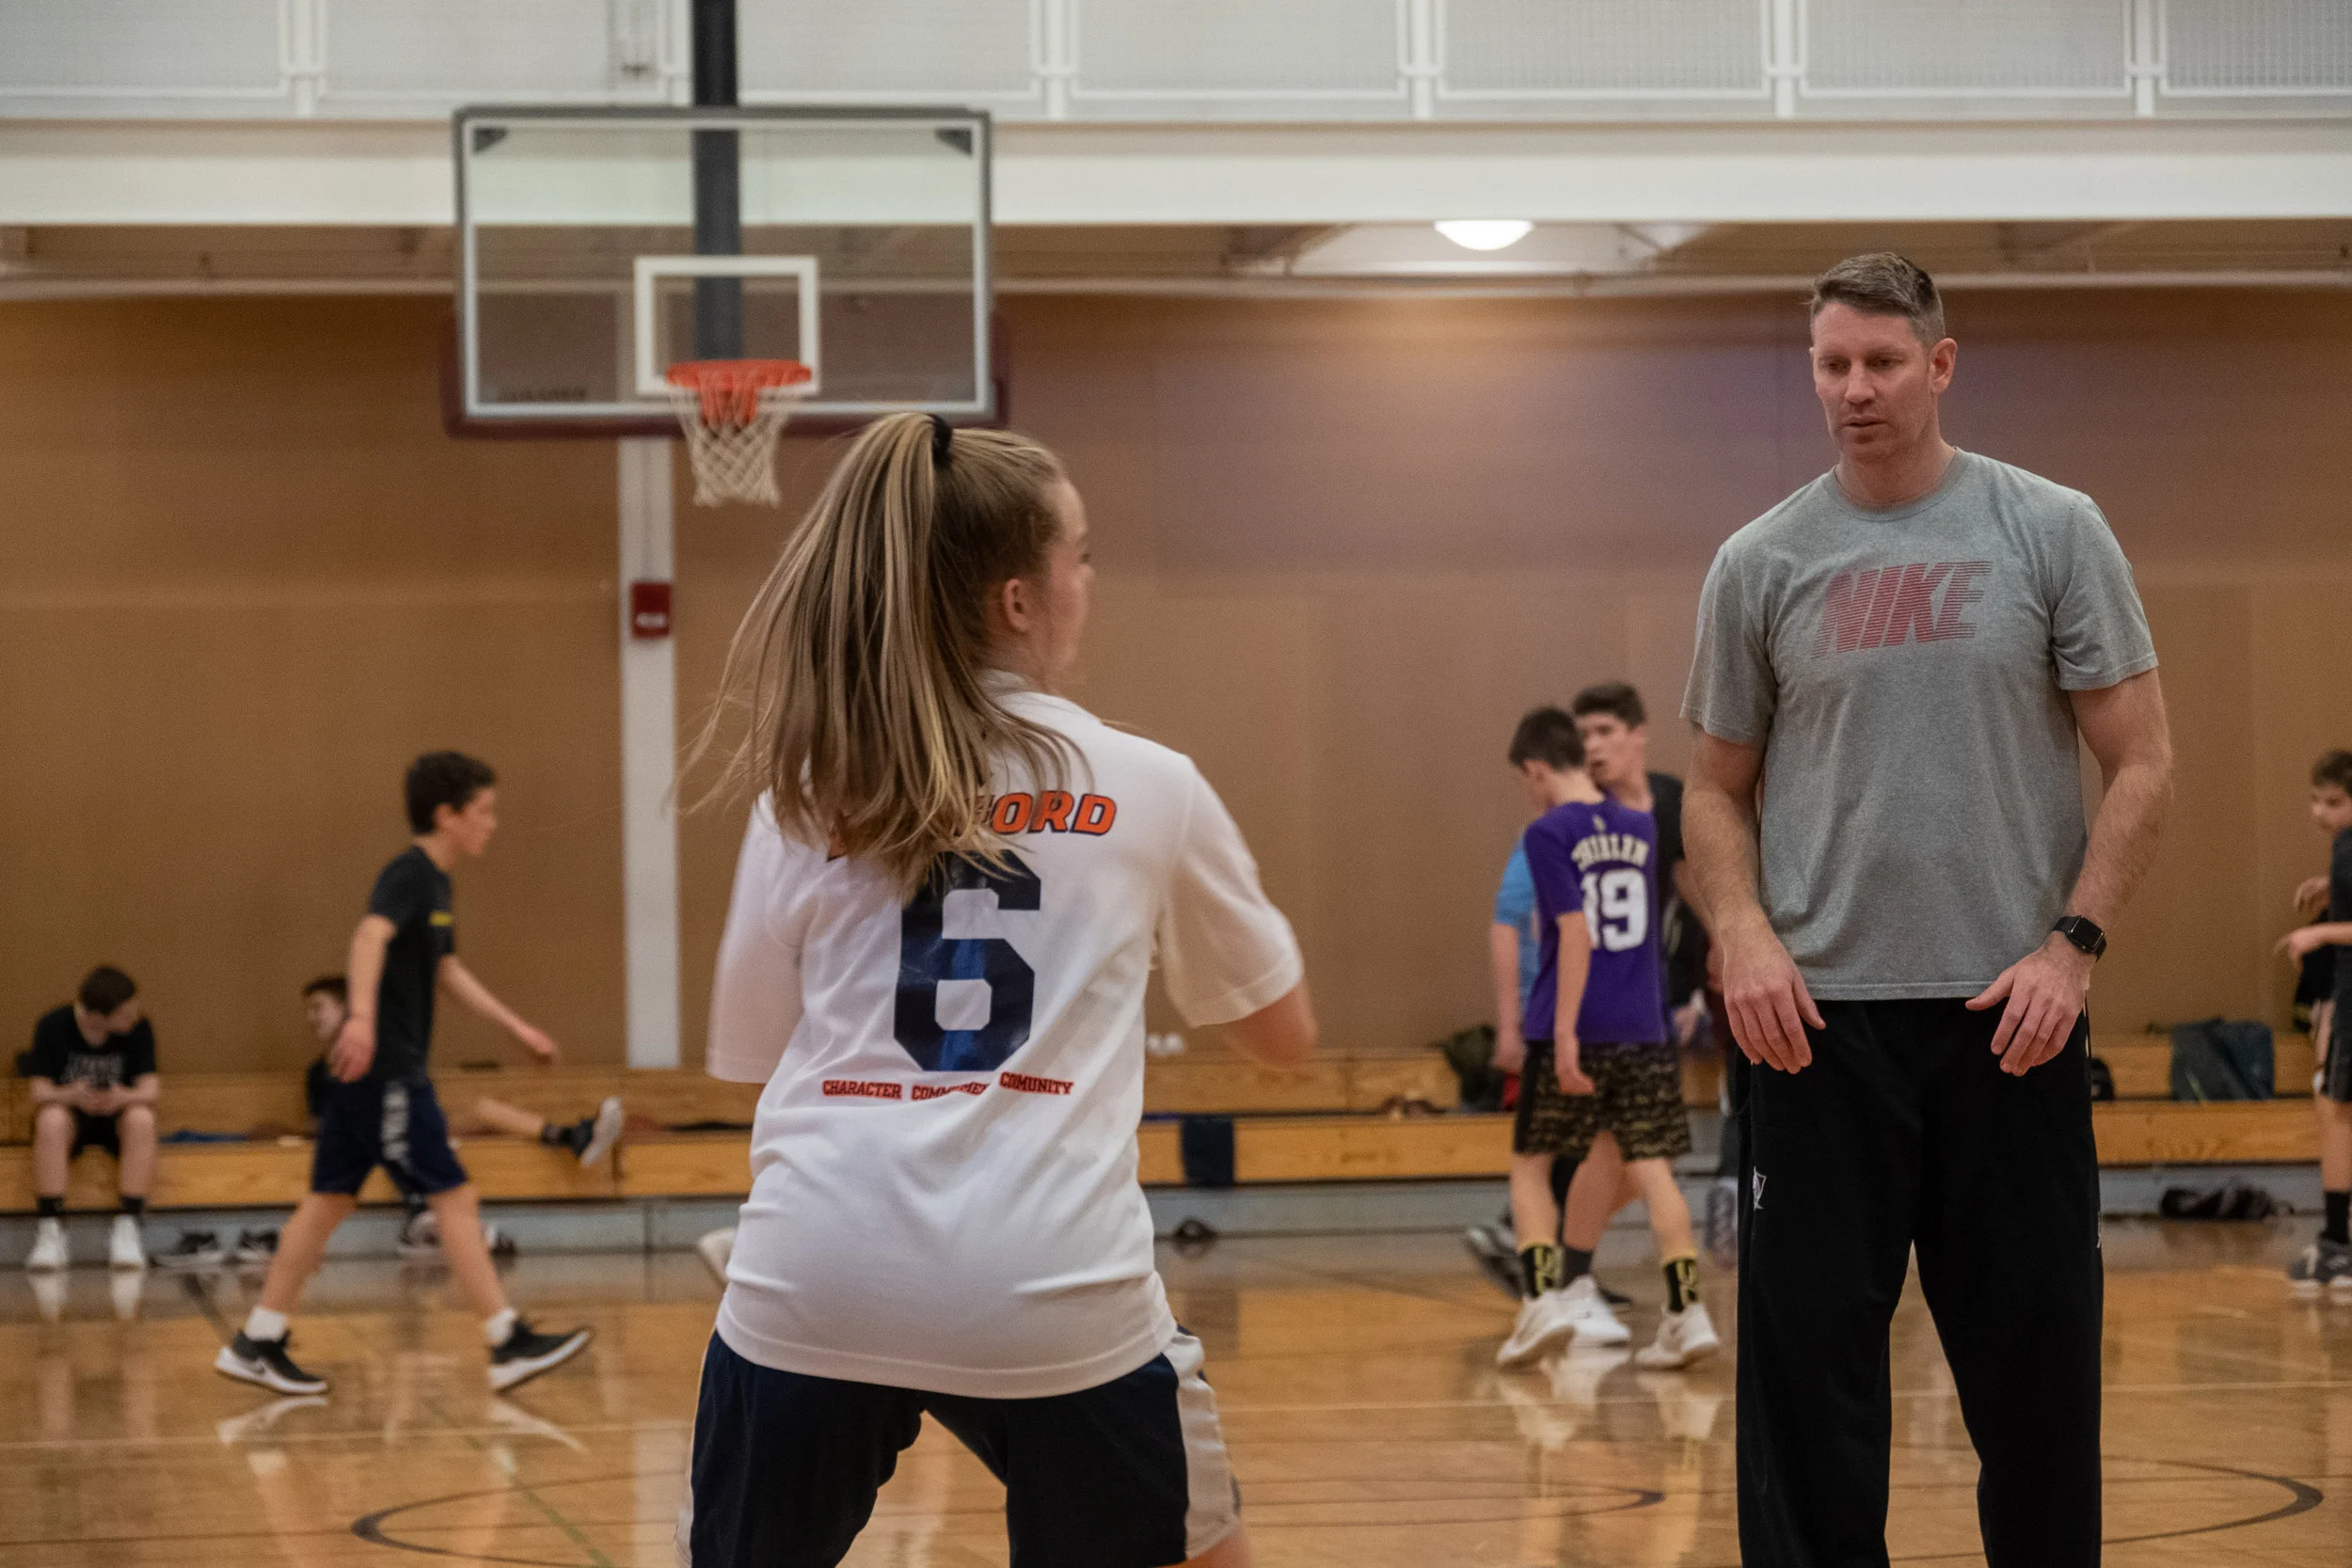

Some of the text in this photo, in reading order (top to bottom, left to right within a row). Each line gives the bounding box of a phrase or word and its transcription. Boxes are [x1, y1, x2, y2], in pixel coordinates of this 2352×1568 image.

[1813, 561, 1993, 657] NIKE
[1581, 869, 1648, 952] 19
[894, 849, 1041, 1072] 6
[822, 1080, 902, 1100] CHARACTER
